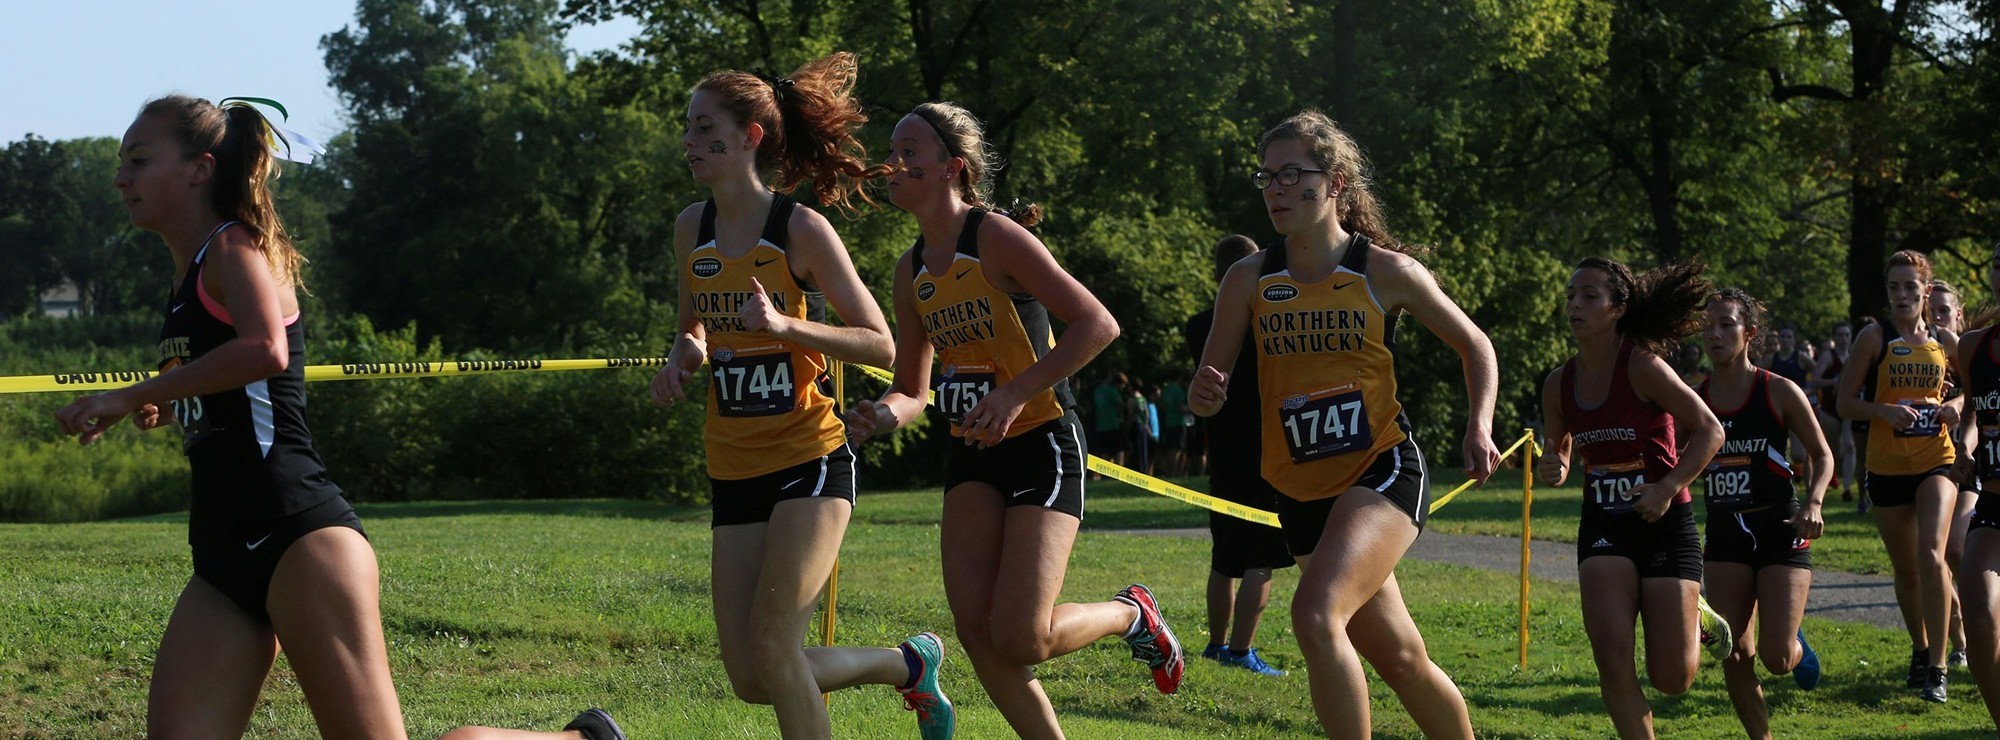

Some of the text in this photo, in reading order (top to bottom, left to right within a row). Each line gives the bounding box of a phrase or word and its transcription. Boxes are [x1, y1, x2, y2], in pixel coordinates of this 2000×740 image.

[924, 297, 992, 334] ORTHERN
[1259, 310, 1366, 335] NORTHERN
[929, 319, 996, 352] ENTUCKY
[1263, 333, 1365, 356] KENTUCKY
[342, 362, 430, 374] CAUTION
[714, 362, 793, 401] 1744
[1891, 377, 1941, 389] KENTUCK
[1284, 400, 1362, 448] 1747
[1573, 427, 1637, 445] EYHOUNDS
[1719, 437, 1768, 454] INNATI
[1705, 470, 1751, 497] 1692
